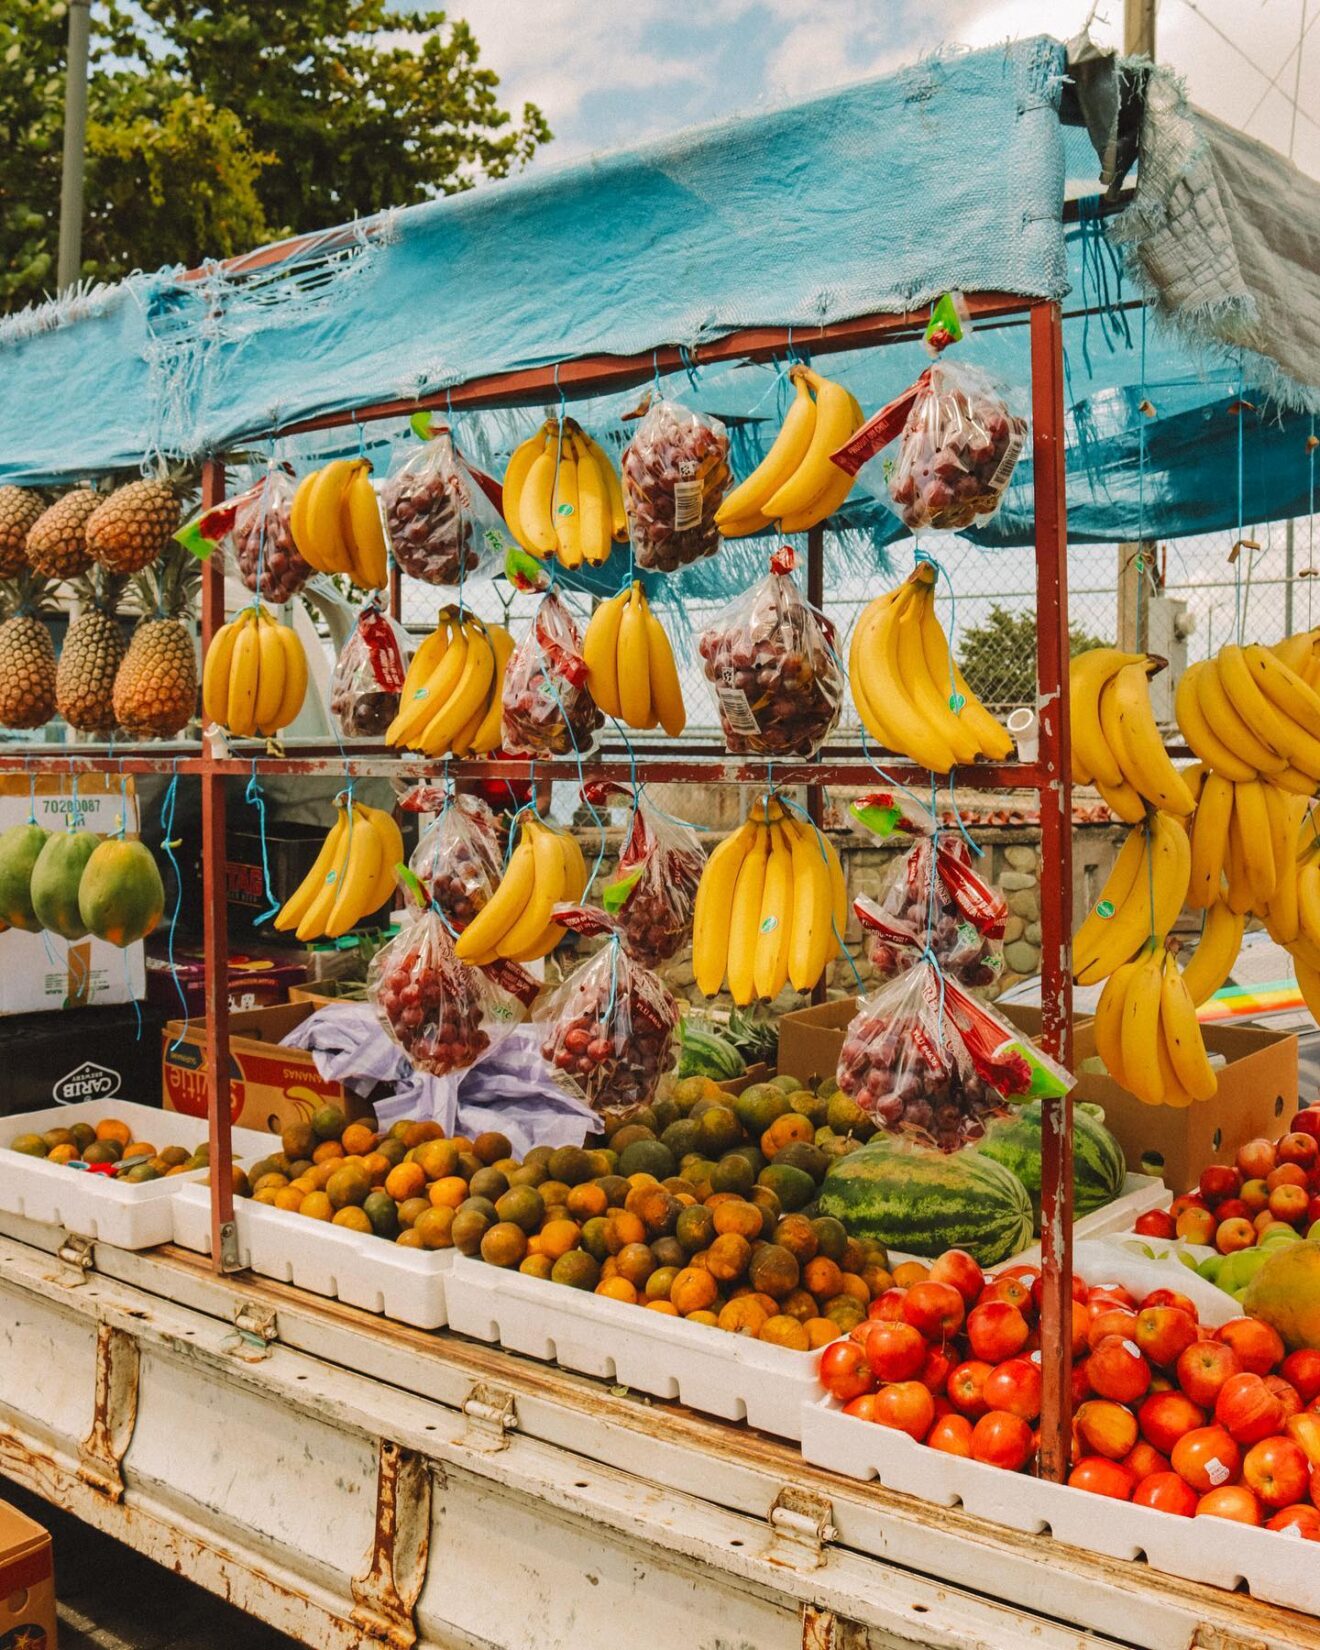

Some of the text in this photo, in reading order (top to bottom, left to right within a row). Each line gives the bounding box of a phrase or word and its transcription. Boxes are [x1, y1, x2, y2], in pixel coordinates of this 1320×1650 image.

[72, 1071, 103, 1082] BREWERY
[282, 1069, 322, 1084] ANANAS
[62, 1077, 112, 1098] CARIB
